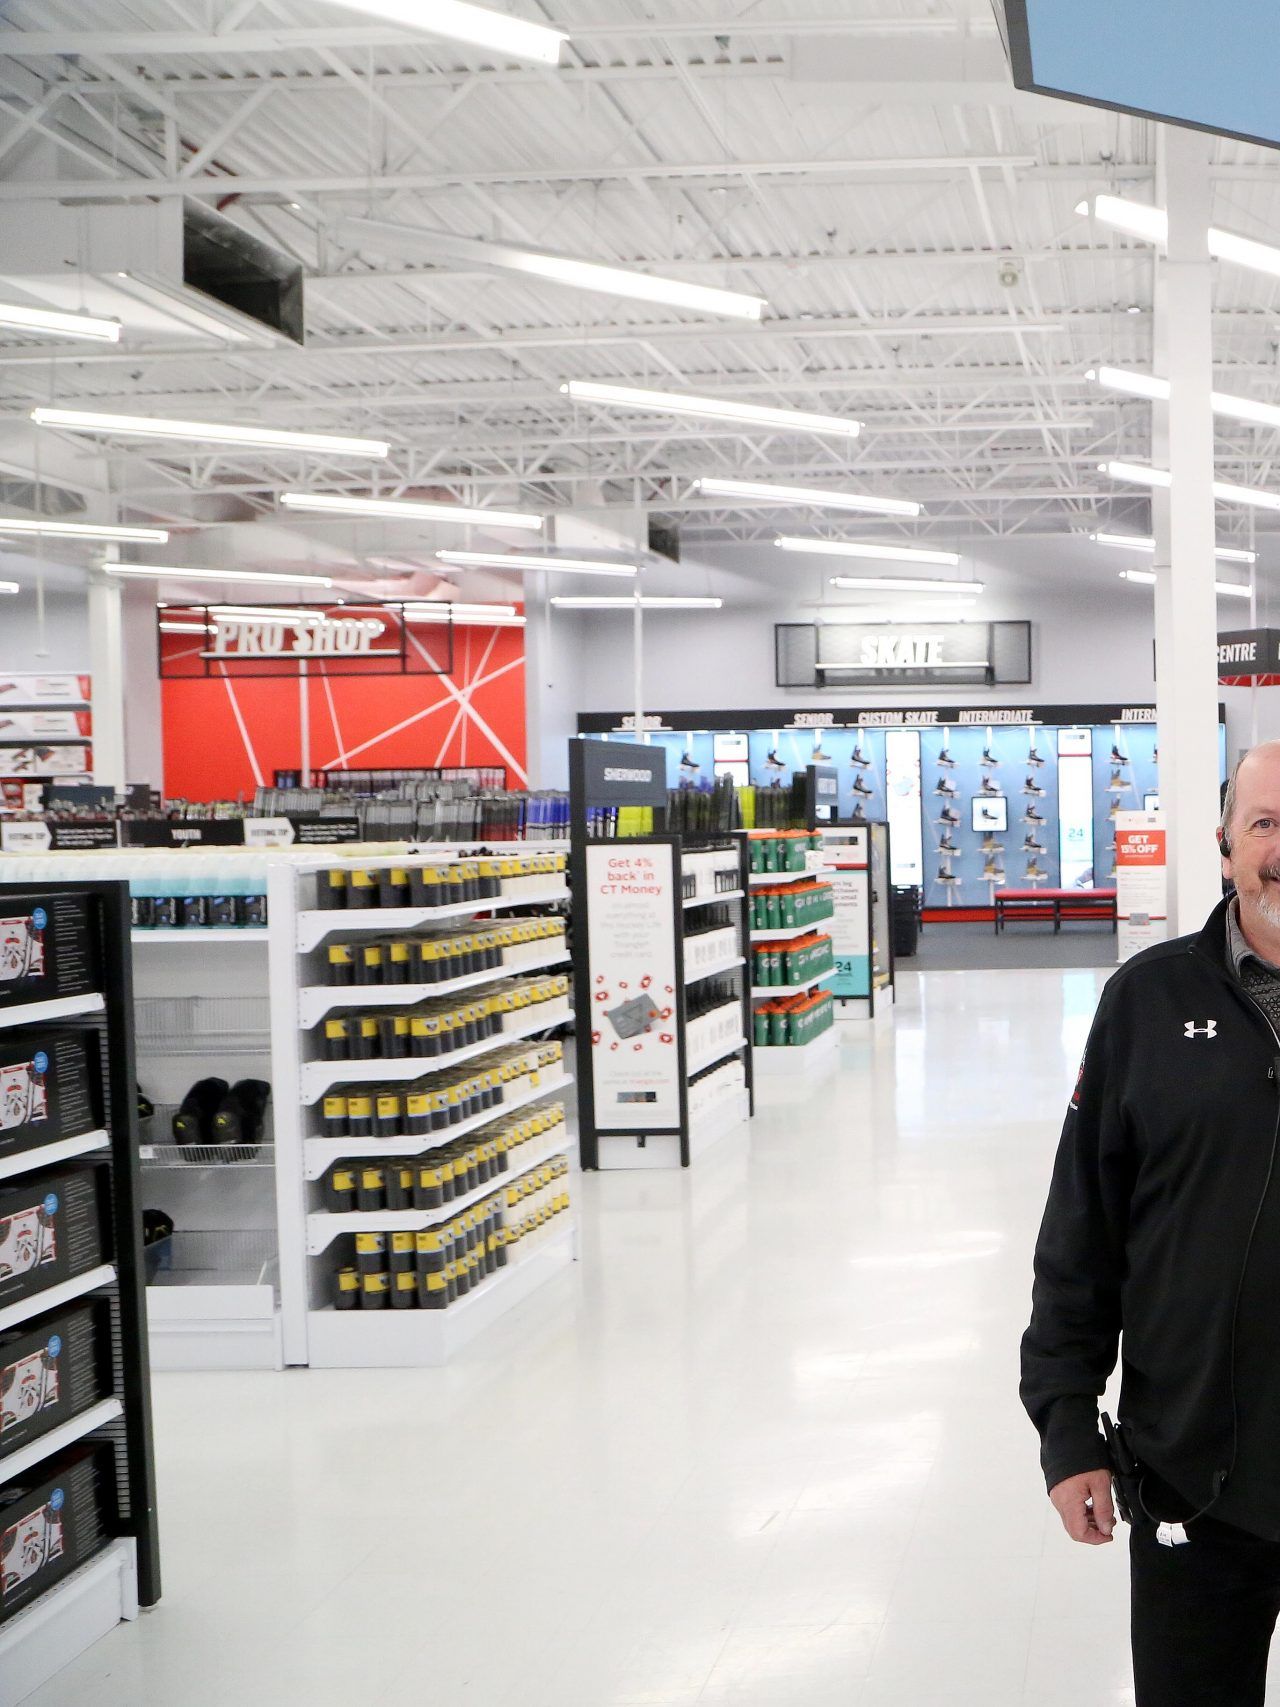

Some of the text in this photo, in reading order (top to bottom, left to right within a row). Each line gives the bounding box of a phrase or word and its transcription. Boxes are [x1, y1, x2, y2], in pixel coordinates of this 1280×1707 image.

[215, 617, 385, 652] PRO SHOP
[860, 634, 945, 664] SKATE
[794, 713, 834, 725] SENIOR
[858, 711, 939, 724] CUSTOM SKATE
[959, 710, 1034, 722] INTERMEDIATE
[171, 828, 202, 840] YOUTH
[1128, 835, 1149, 844] GET
[1137, 844, 1158, 854] OFF
[608, 858, 630, 868] Get
[643, 872, 655, 881] in
[600, 885, 662, 896] CT Money
